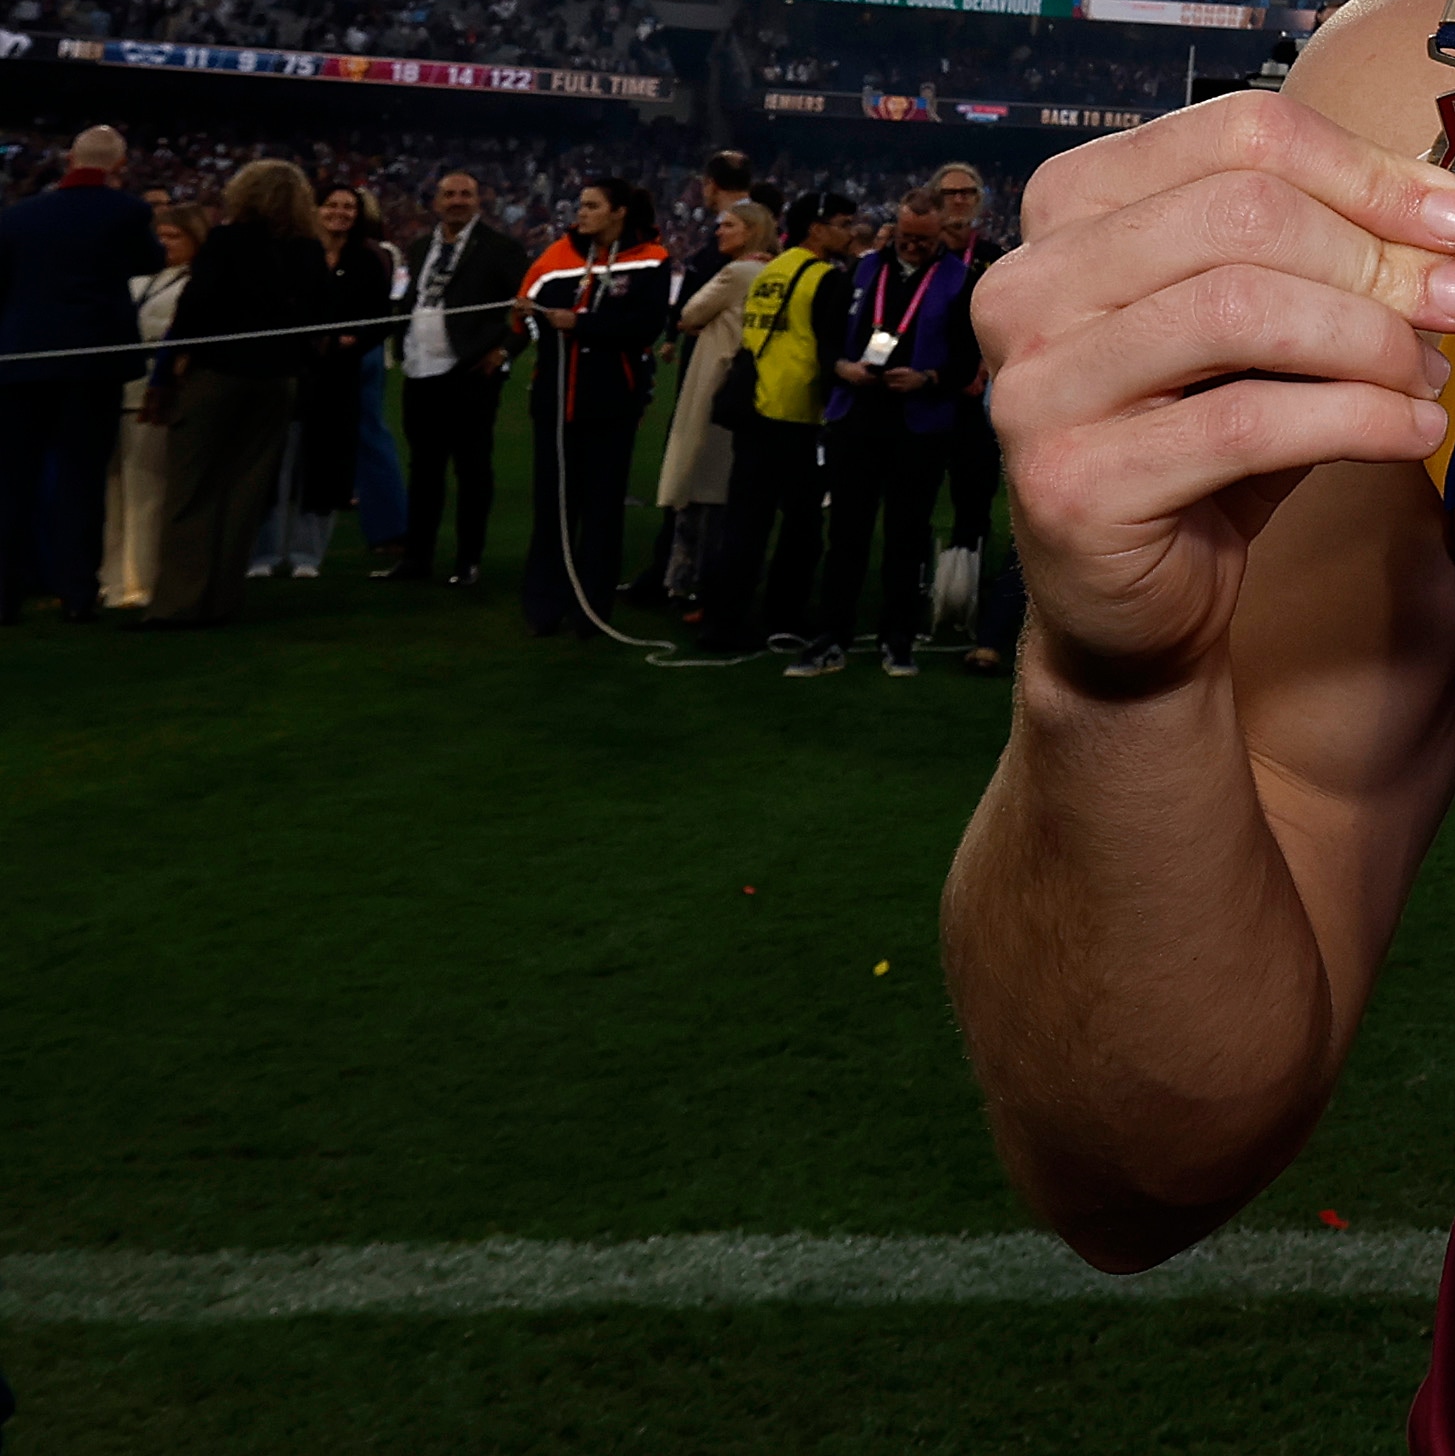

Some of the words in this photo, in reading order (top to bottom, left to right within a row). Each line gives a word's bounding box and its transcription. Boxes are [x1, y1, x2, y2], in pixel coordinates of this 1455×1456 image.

[184, 46, 209, 69] 11
[238, 50, 258, 73] 9
[283, 53, 318, 76] 75
[390, 61, 421, 84] 18
[447, 64, 474, 86] 14
[489, 68, 534, 91] 122
[551, 72, 602, 95] FULL
[607, 75, 661, 97] TIME
